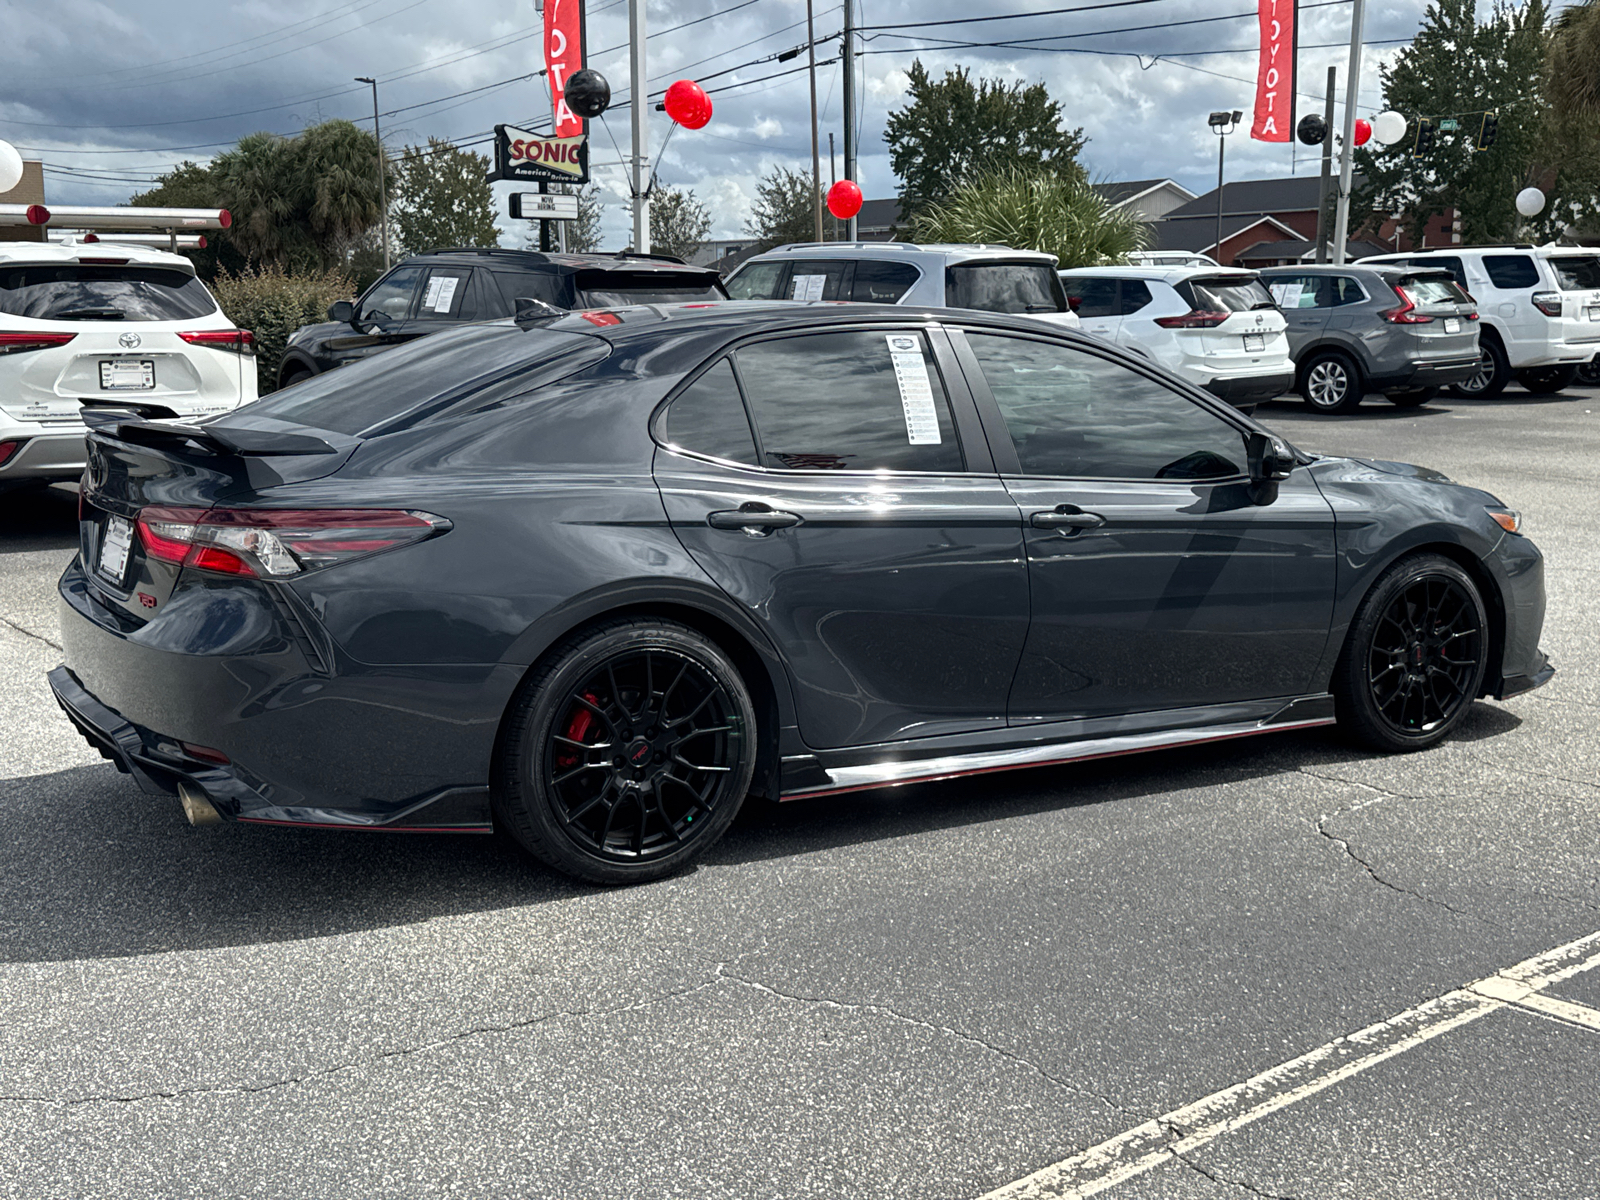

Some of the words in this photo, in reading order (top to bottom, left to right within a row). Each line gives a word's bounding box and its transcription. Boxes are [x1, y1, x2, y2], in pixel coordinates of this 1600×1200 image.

[511, 139, 581, 164] SONIC
[514, 167, 551, 177] America's
[550, 174, 579, 182] Drive-In
[537, 203, 556, 211] HIRING
